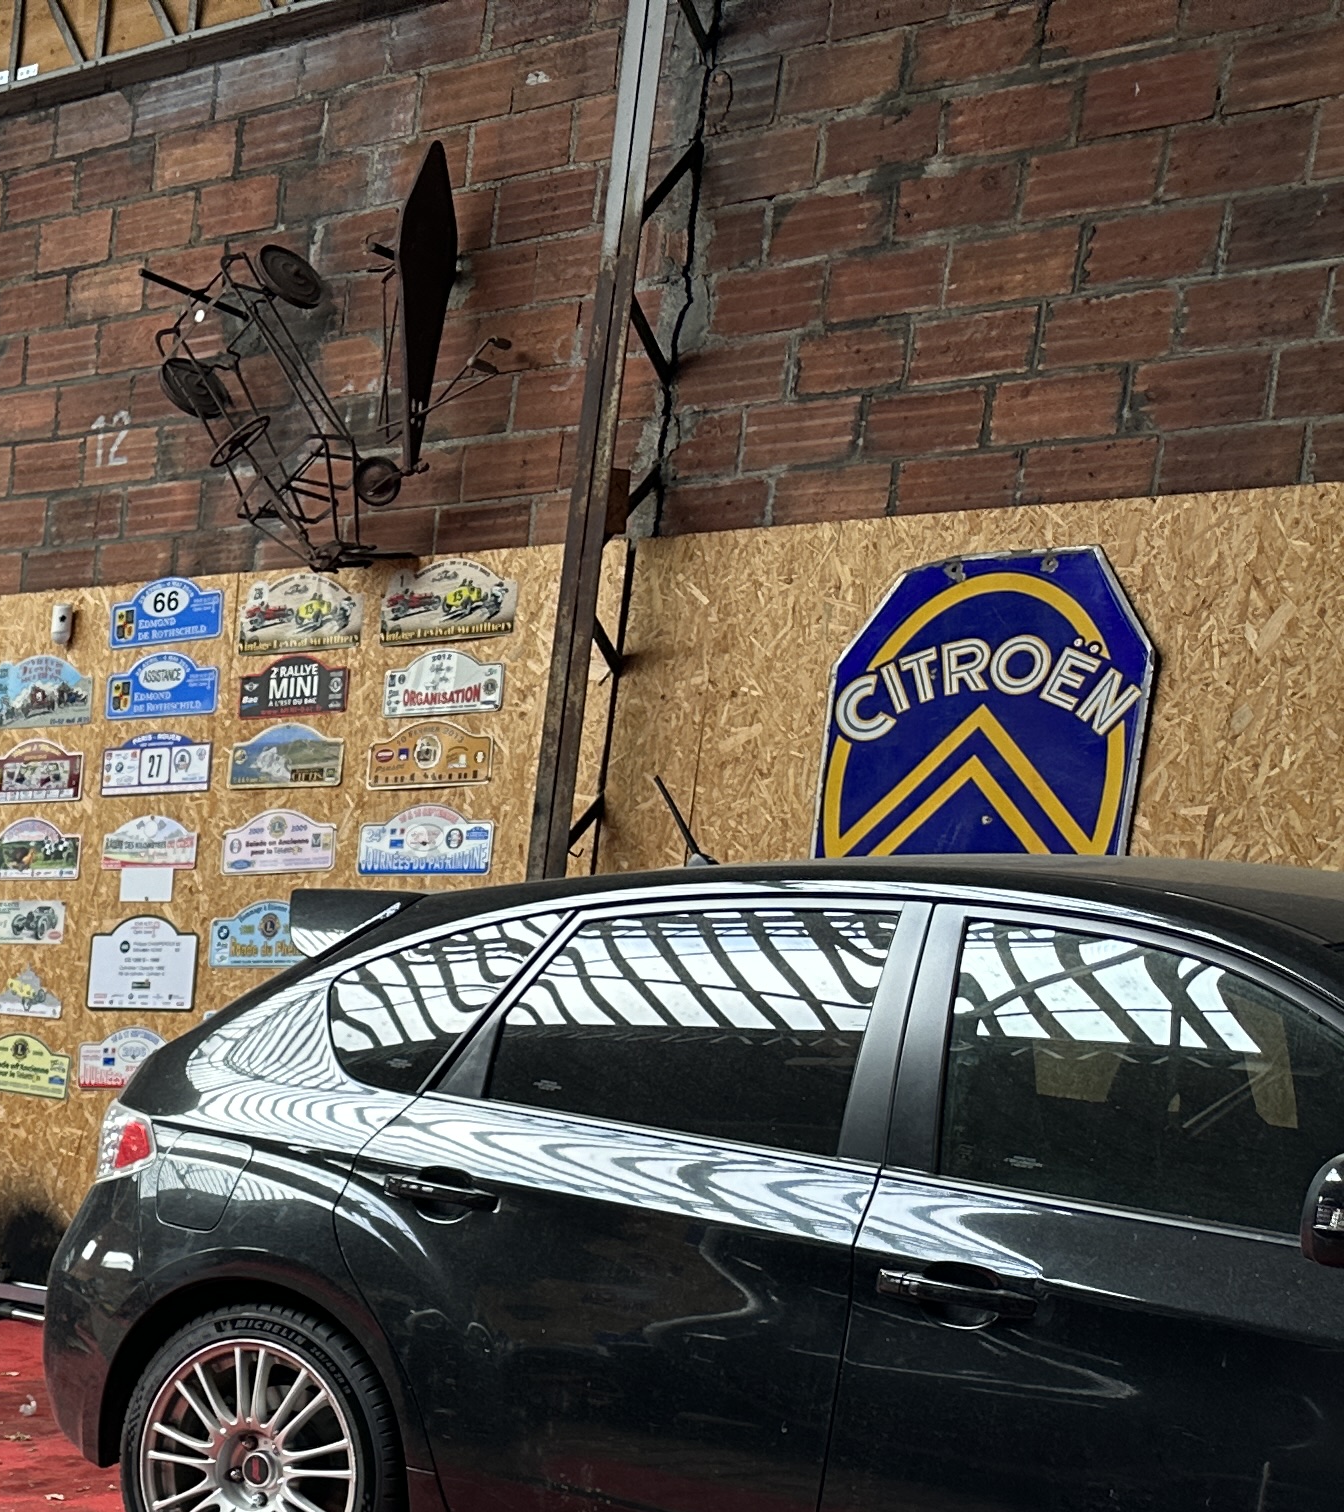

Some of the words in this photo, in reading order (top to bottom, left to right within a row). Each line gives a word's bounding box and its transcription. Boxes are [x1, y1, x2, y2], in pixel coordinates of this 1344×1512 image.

[91, 410, 131, 467] 12
[154, 590, 179, 613] 66
[137, 632, 149, 641] DE
[152, 624, 207, 640] ROTHSCHILD
[138, 617, 177, 629] EDMOND
[143, 667, 182, 683] ASSISTANCE
[280, 664, 319, 676] RALLYE
[134, 691, 172, 702] EDMOND
[268, 675, 318, 700] MINI
[403, 683, 481, 707] ORGANISATION
[835, 635, 1142, 741] CITROËN
[133, 704, 144, 713] DE
[146, 700, 202, 712] ROTHSCHILD
[147, 754, 163, 778] 27
[411, 856, 426, 870] DU
[428, 843, 488, 870] PATRIMOINE
[234, 1320, 305, 1346] MICHELIN
